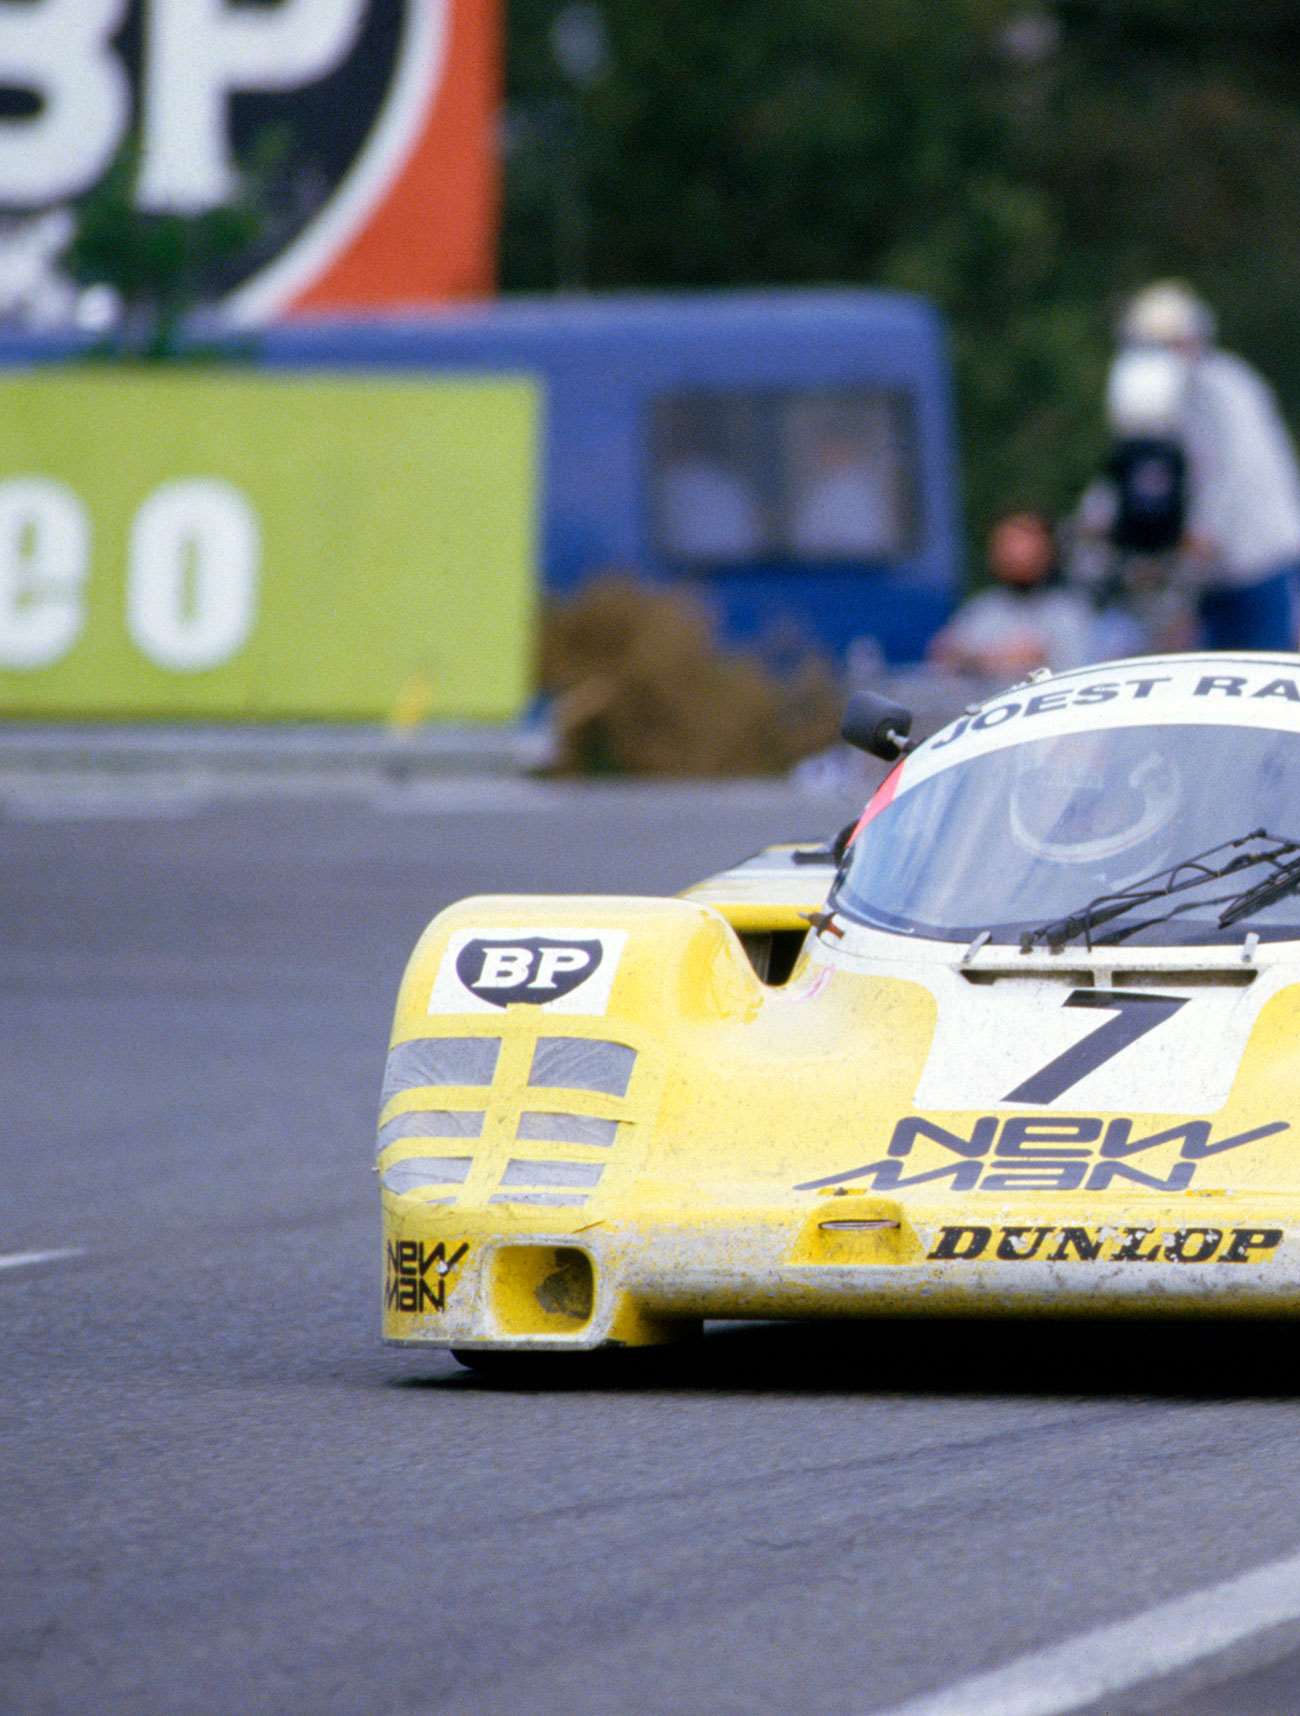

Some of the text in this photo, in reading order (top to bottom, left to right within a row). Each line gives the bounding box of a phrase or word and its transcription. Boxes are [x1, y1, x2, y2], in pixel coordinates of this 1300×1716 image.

[931, 677, 1174, 750] JOEST
[471, 946, 591, 989] BP
[1000, 990, 1191, 1105] 7
[926, 1226, 1284, 1263] DUNLOP
